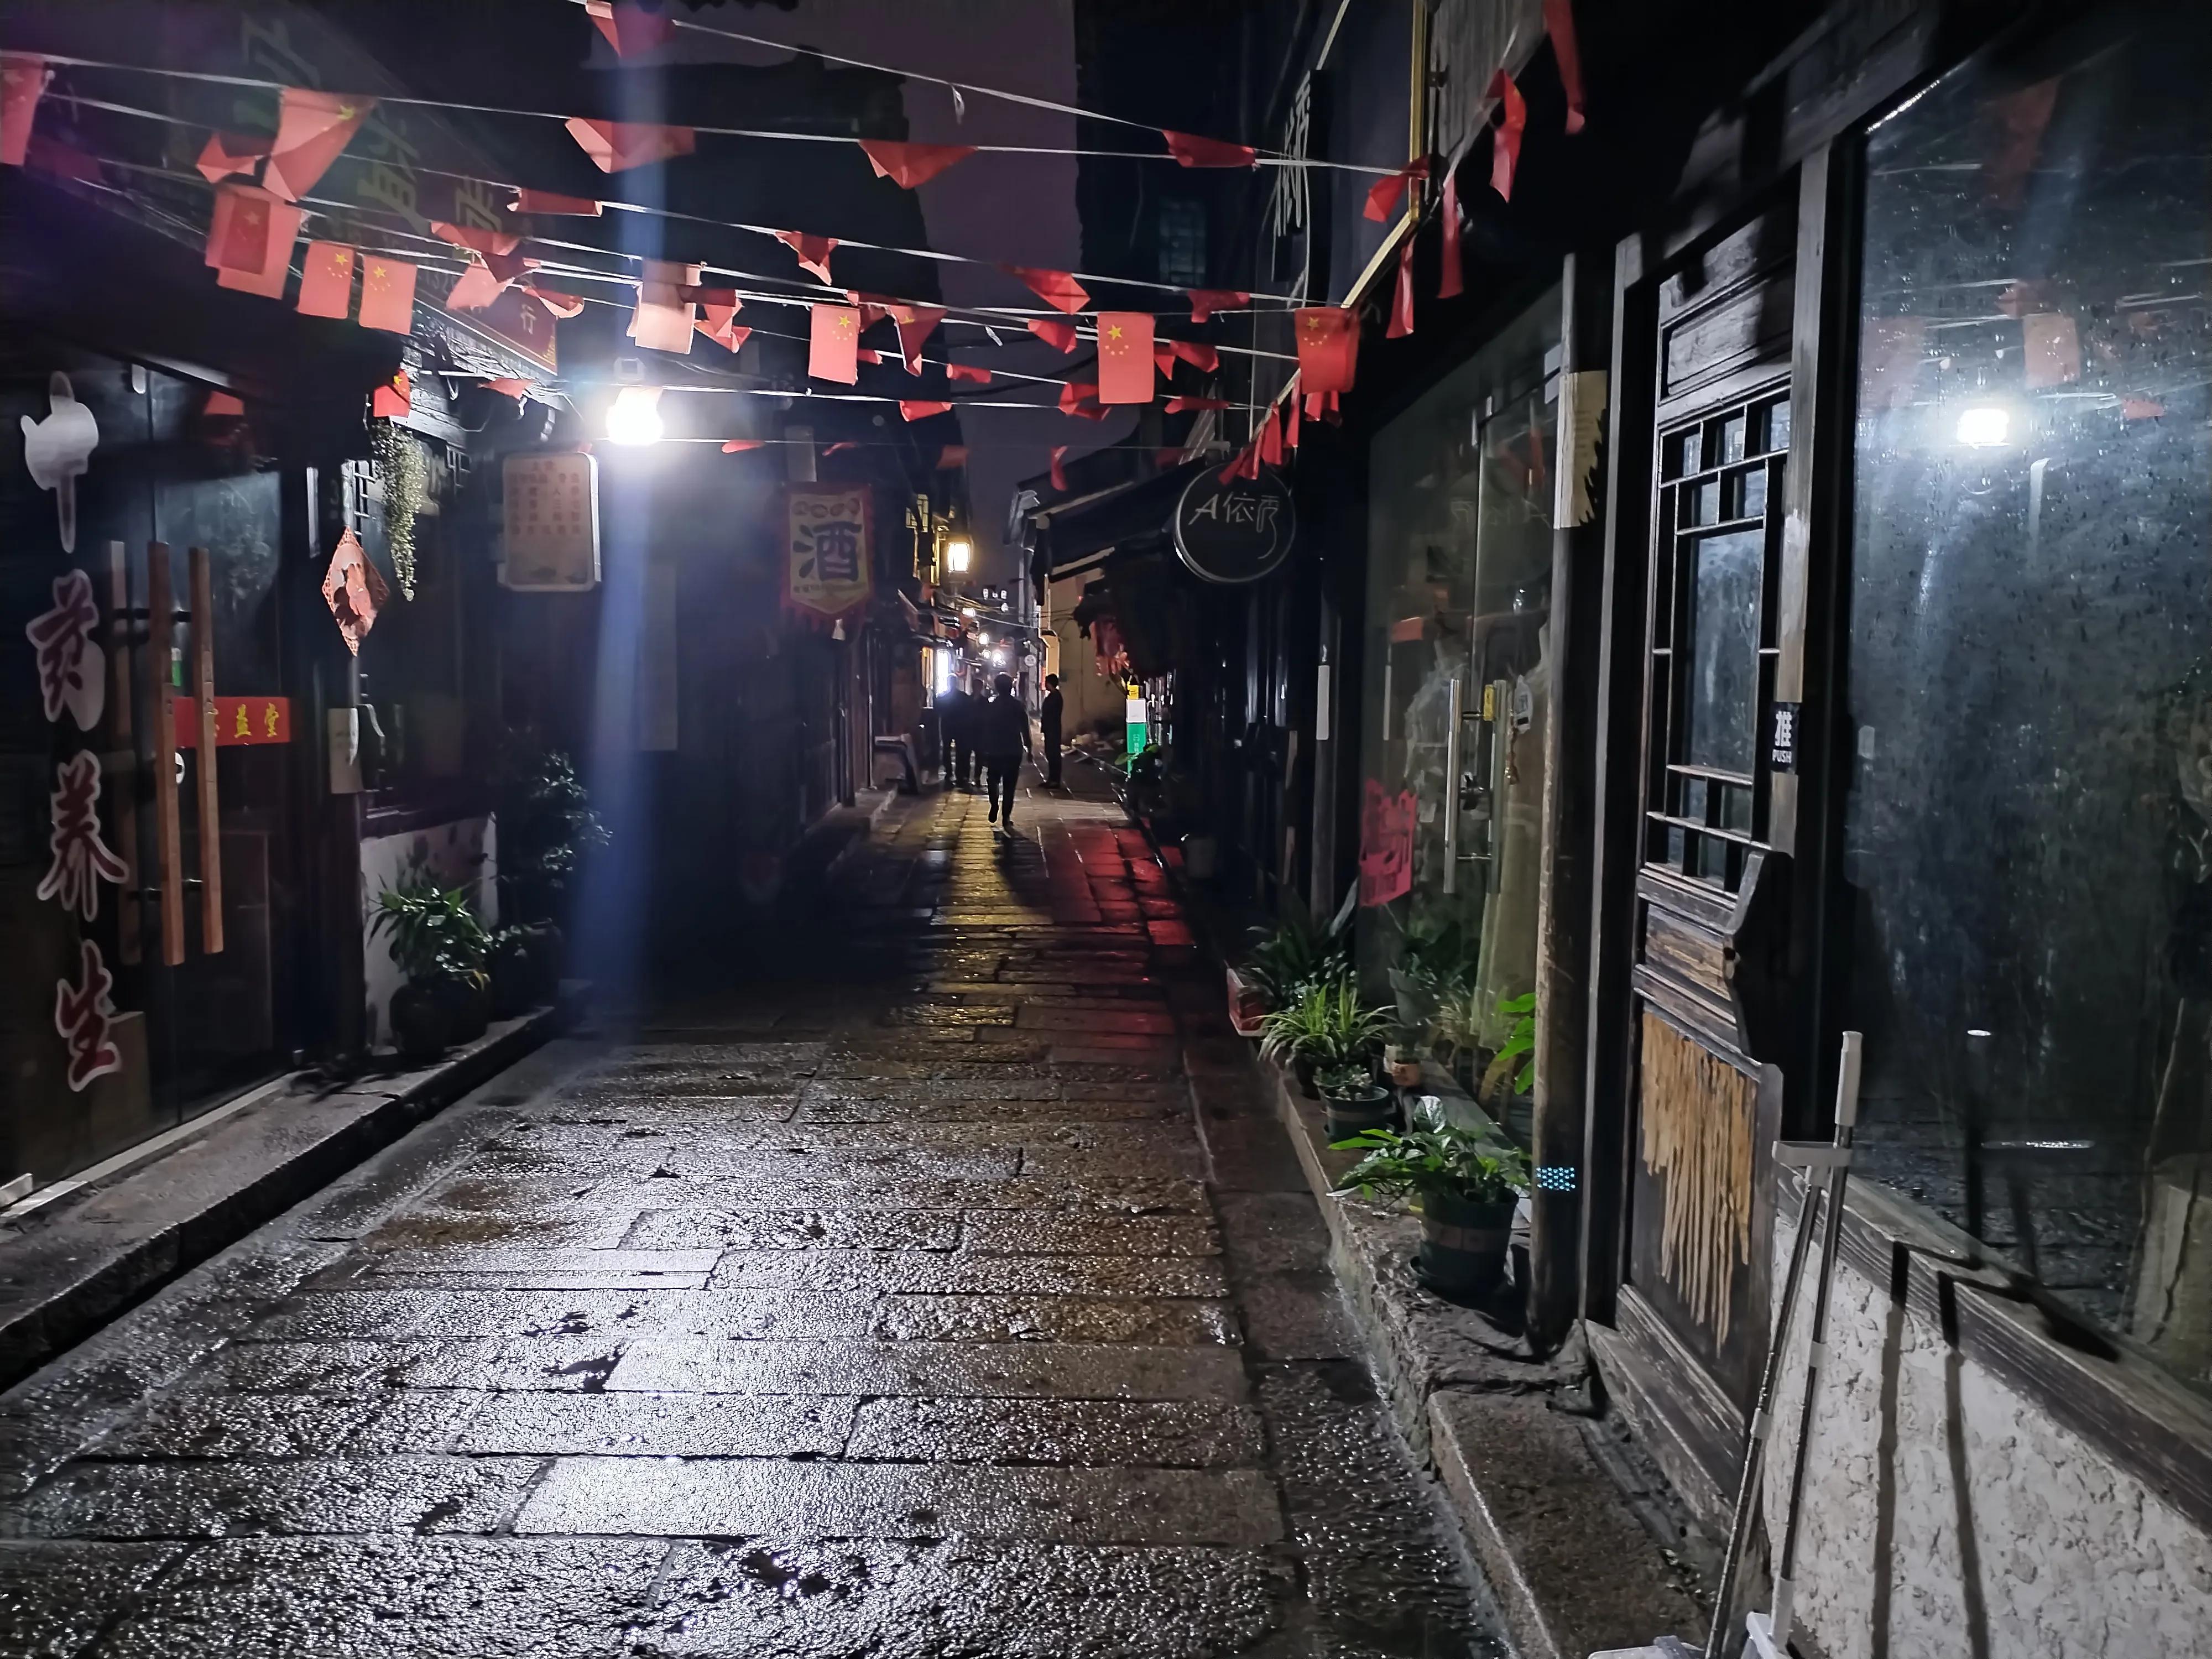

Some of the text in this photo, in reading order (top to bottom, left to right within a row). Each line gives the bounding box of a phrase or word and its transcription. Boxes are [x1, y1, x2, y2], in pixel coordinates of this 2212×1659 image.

[792, 520, 862, 582] 酒
[1775, 711, 1793, 747] 推
[1772, 748, 1792, 764] PUSH
